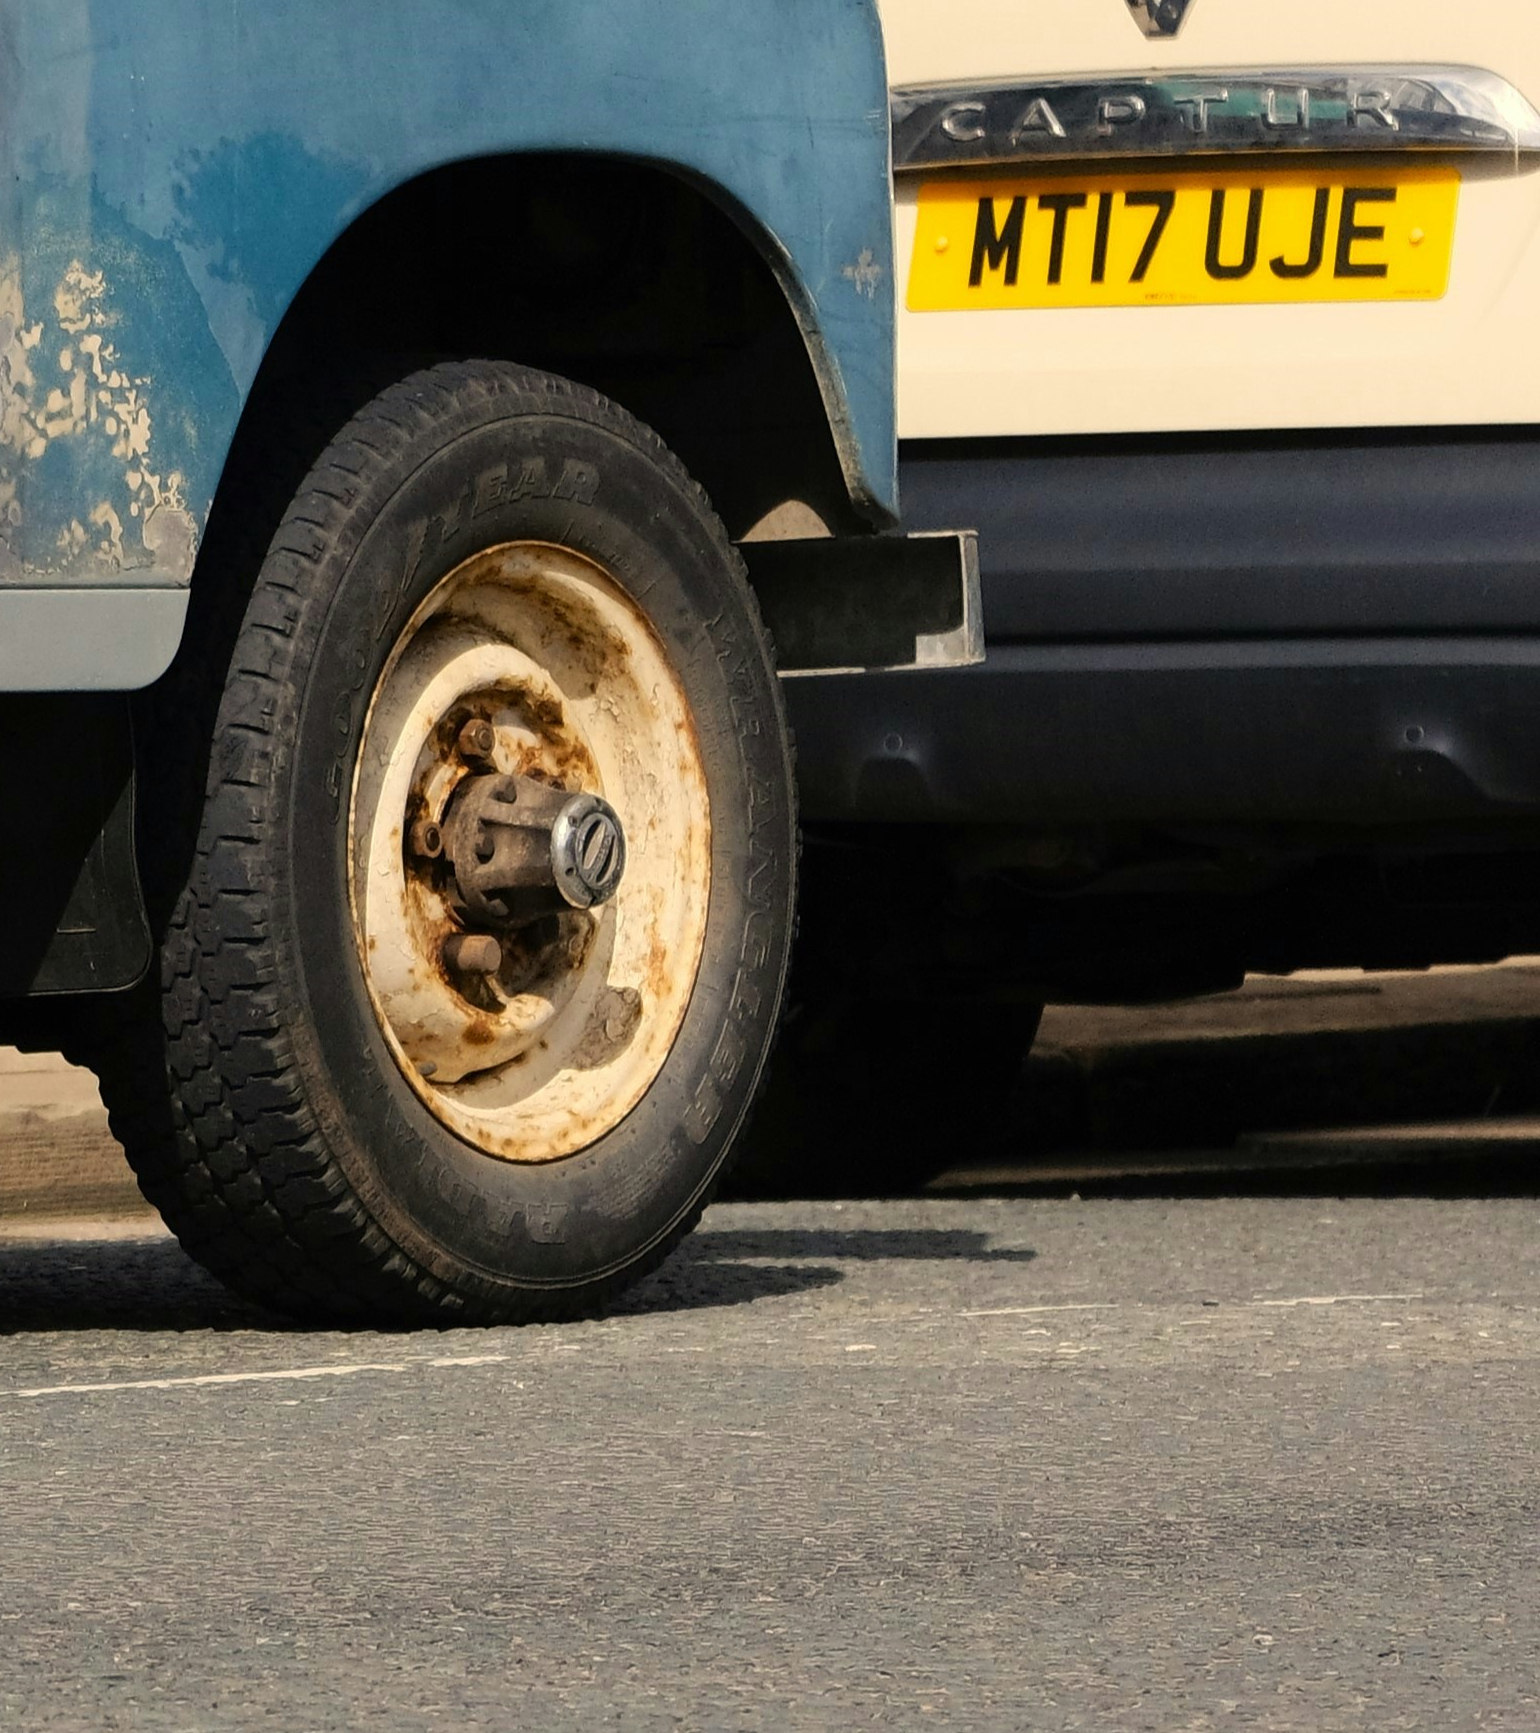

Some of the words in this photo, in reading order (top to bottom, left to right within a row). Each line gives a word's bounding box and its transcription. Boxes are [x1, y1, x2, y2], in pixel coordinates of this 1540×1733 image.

[939, 88, 1400, 144] CAPTUR
[966, 190, 1177, 288] MT17
[1203, 187, 1400, 280] UJE
